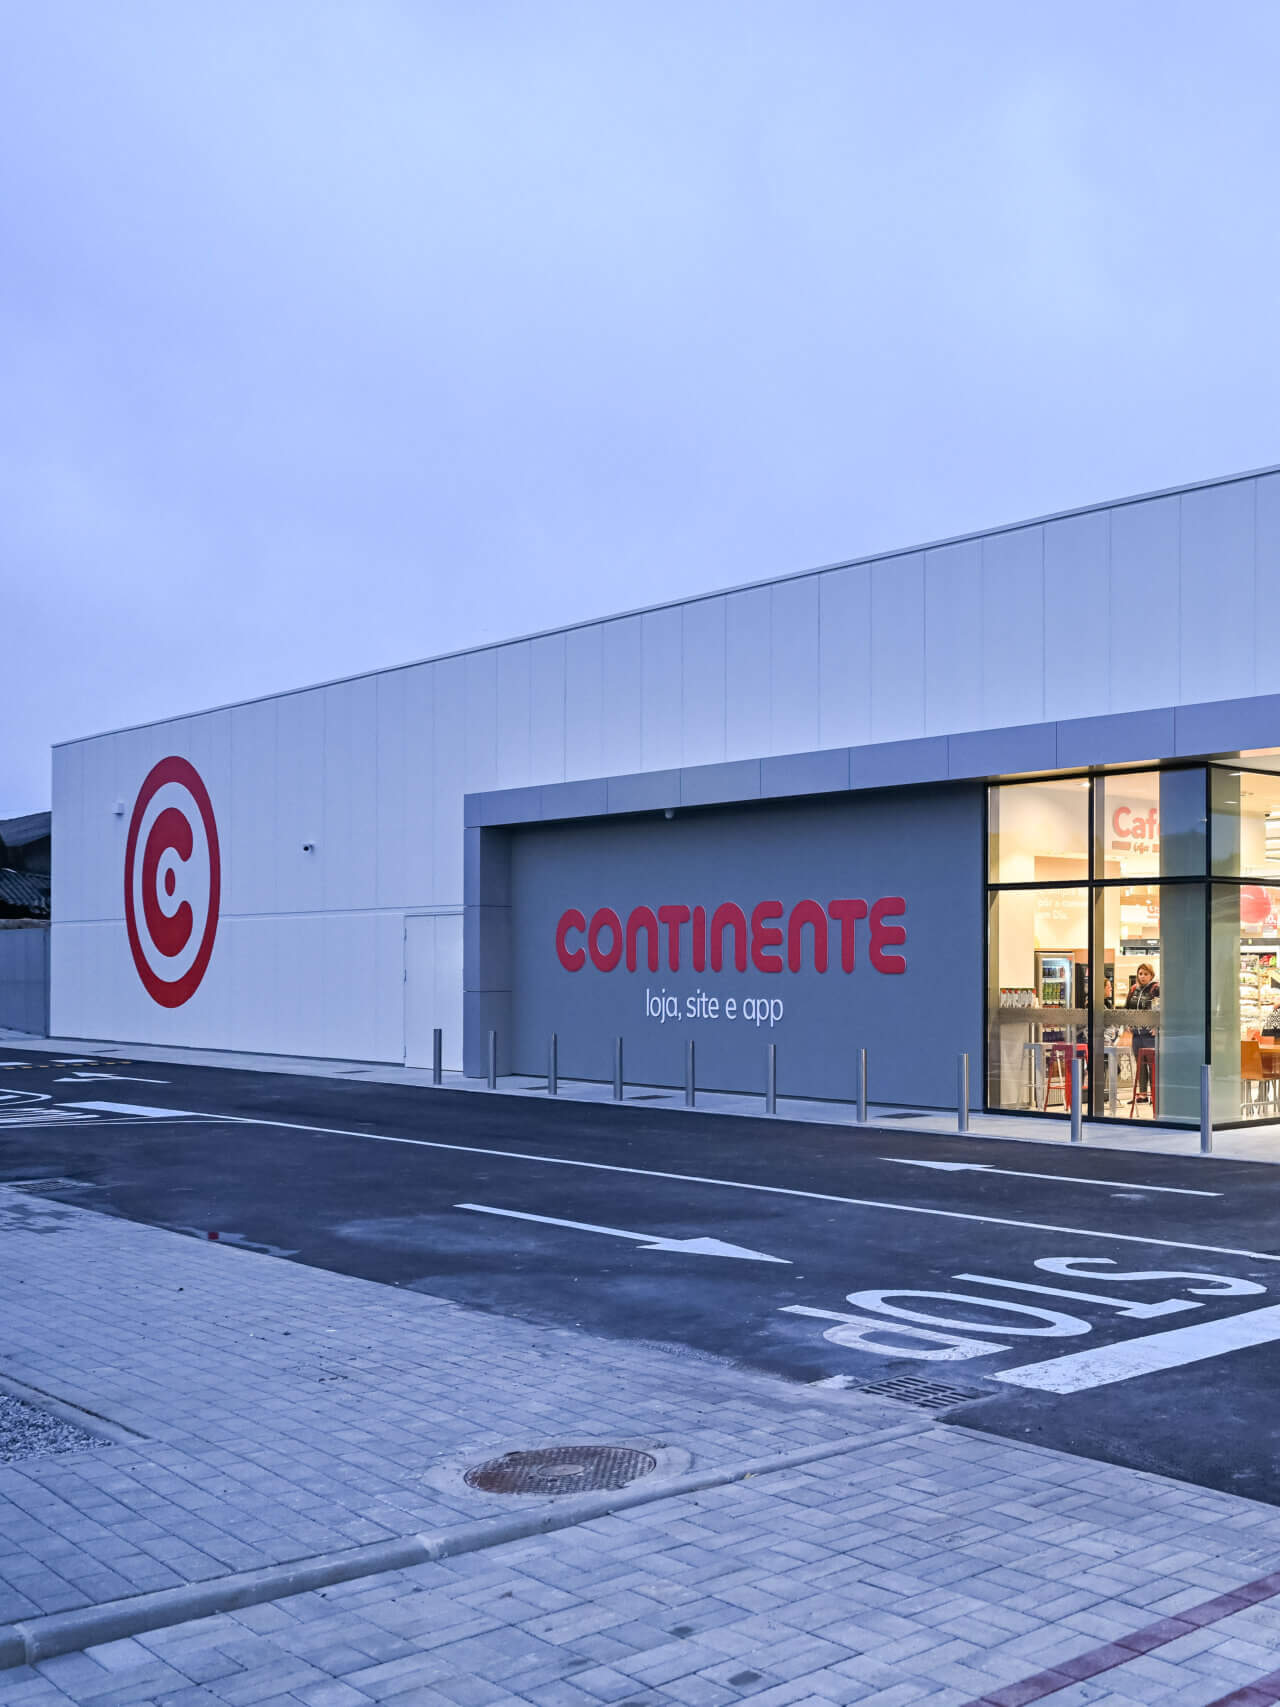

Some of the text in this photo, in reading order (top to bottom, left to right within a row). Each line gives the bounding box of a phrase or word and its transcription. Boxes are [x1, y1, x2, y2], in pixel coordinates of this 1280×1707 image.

[1112, 806, 1160, 839] Caf
[556, 897, 907, 974] CONTINENTE
[646, 988, 784, 1027] loja, site e app
[778, 1256, 1268, 1361] STOP
